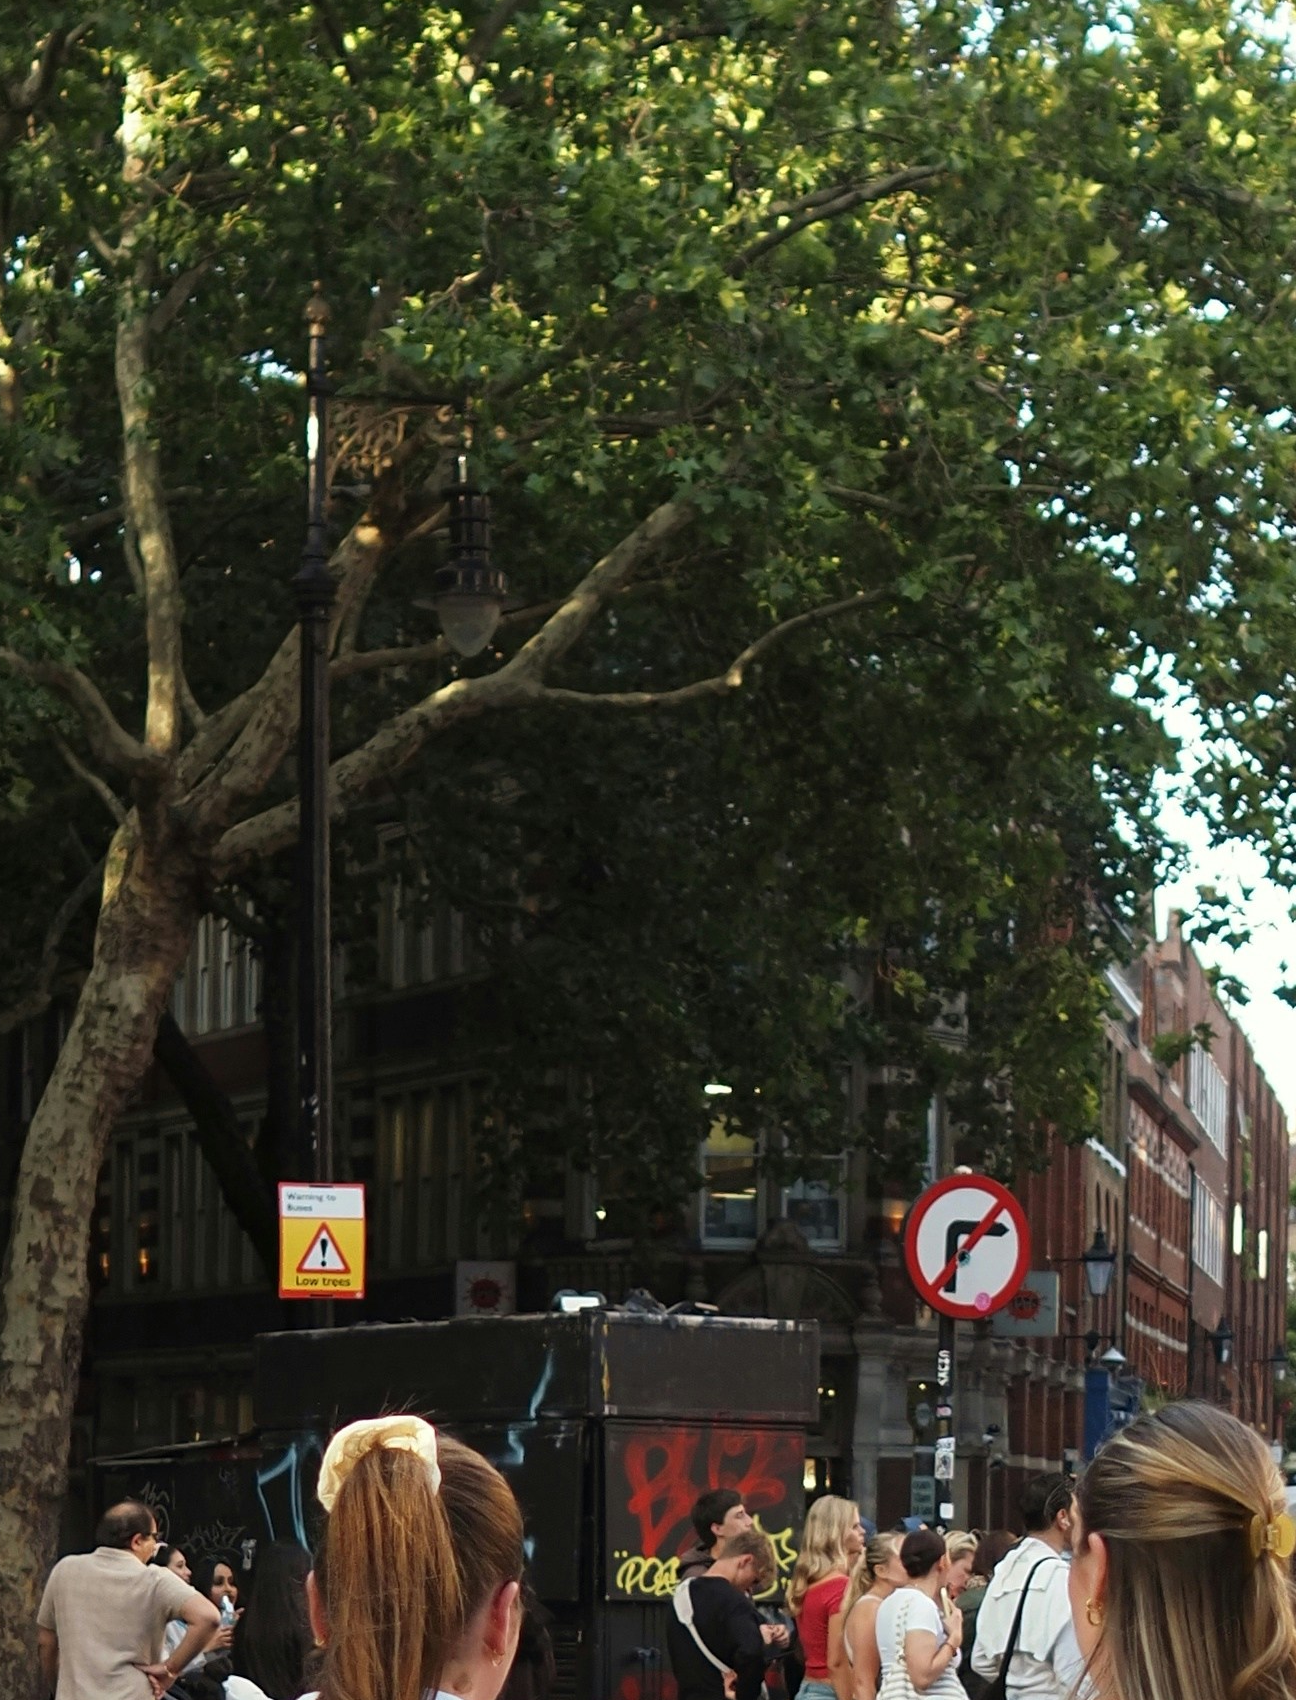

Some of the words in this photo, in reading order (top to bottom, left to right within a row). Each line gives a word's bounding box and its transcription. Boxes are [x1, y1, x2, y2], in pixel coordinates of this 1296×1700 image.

[287, 1204, 313, 1212] Buses
[295, 1275, 319, 1287] Low
[322, 1277, 351, 1288] trees
